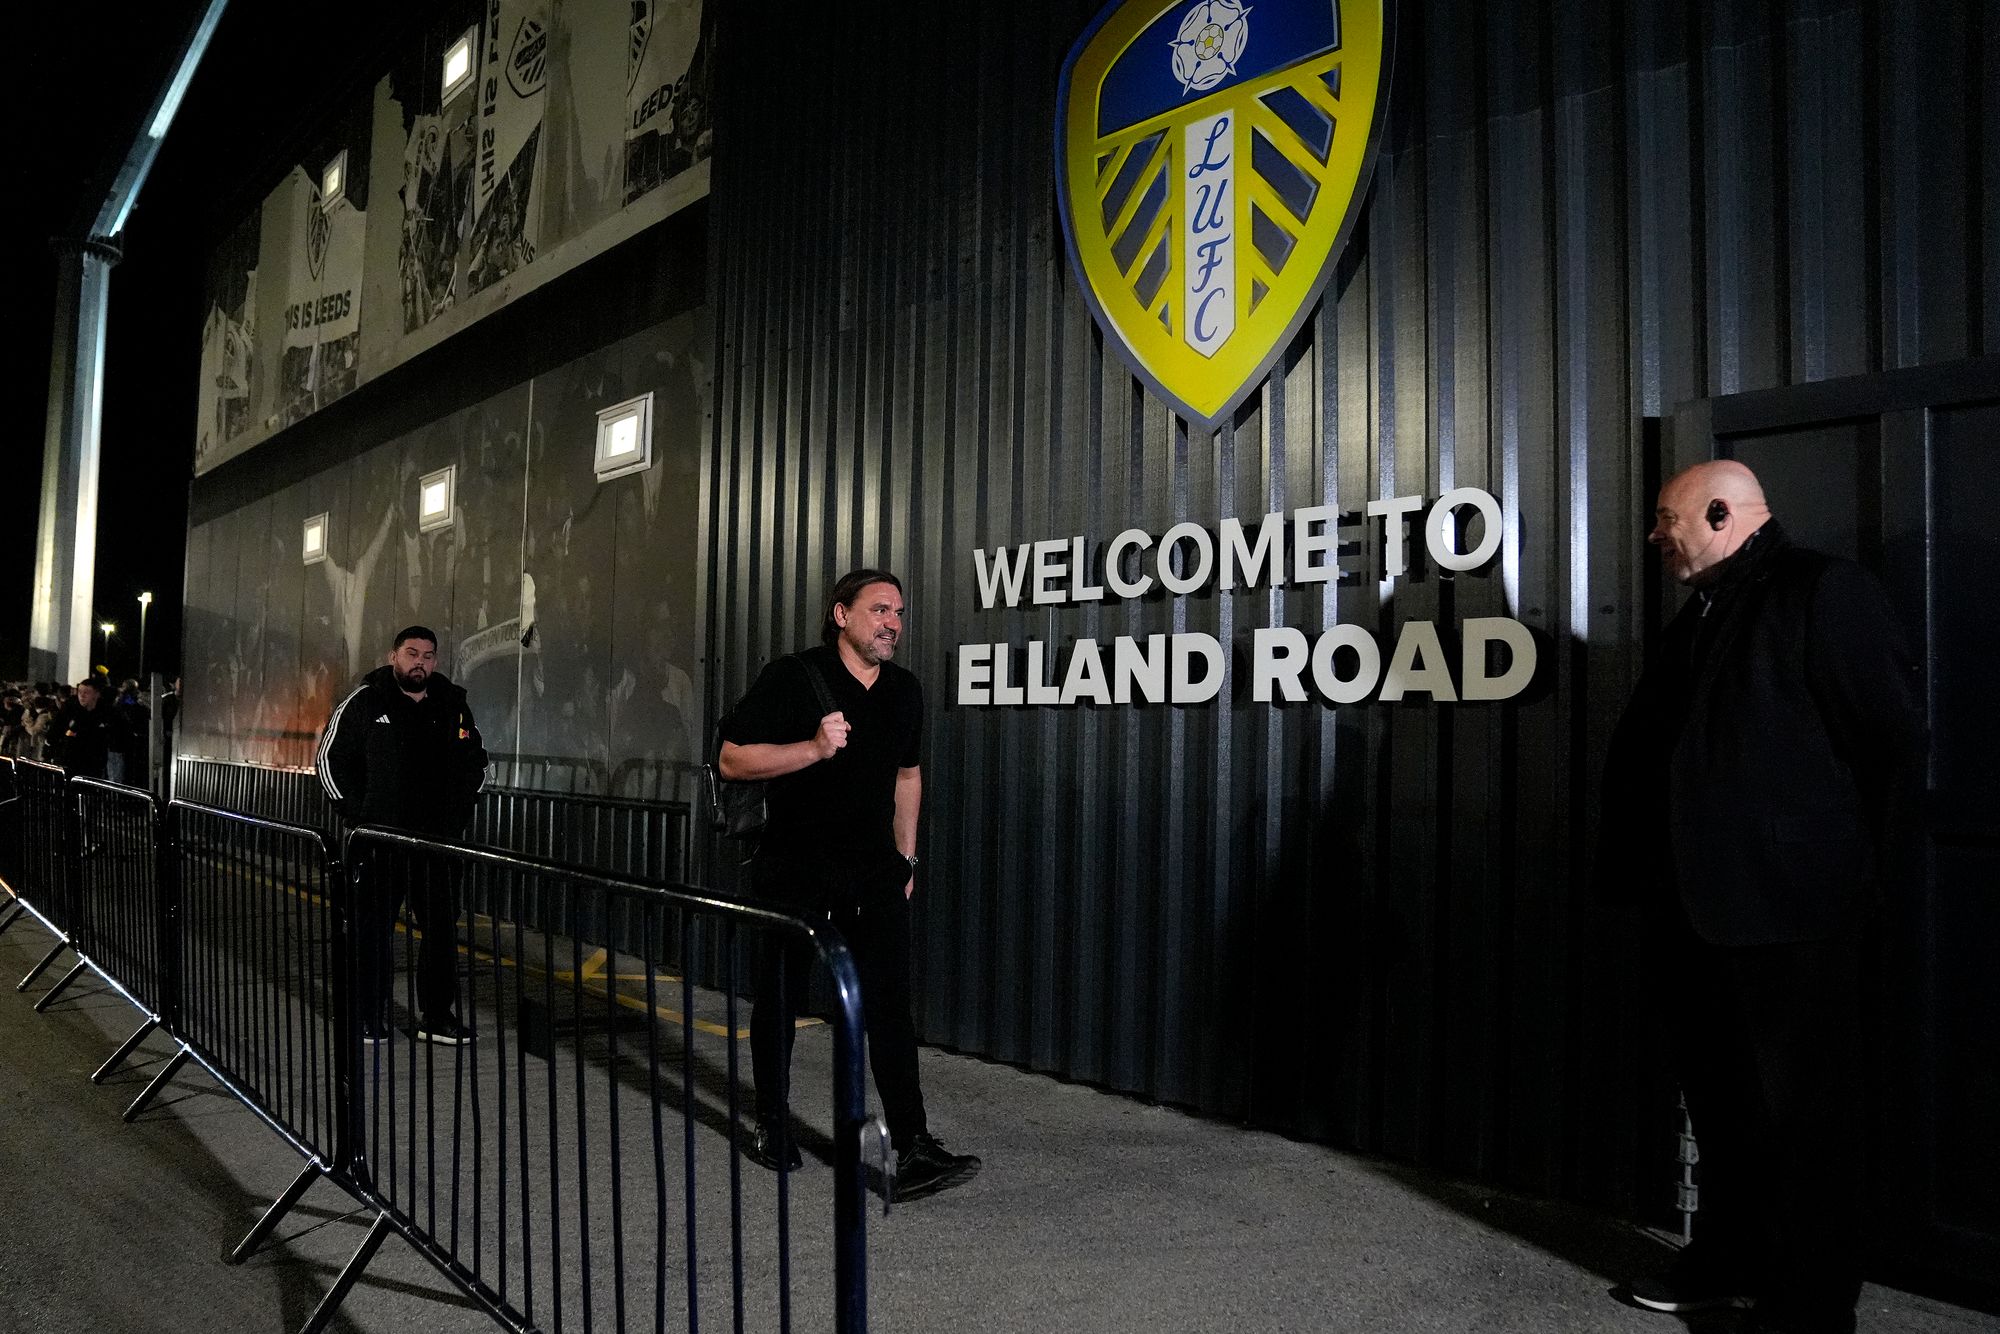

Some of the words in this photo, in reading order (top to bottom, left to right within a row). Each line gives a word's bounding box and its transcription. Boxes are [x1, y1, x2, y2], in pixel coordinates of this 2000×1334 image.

[1189, 116, 1231, 343] LUFC
[301, 301, 313, 328] IS
[314, 289, 352, 326] LEEDS
[973, 503, 1340, 609] WELCOME
[1367, 486, 1504, 577] TO
[957, 632, 1226, 705] ELLAND
[1252, 616, 1538, 704] ROAD
